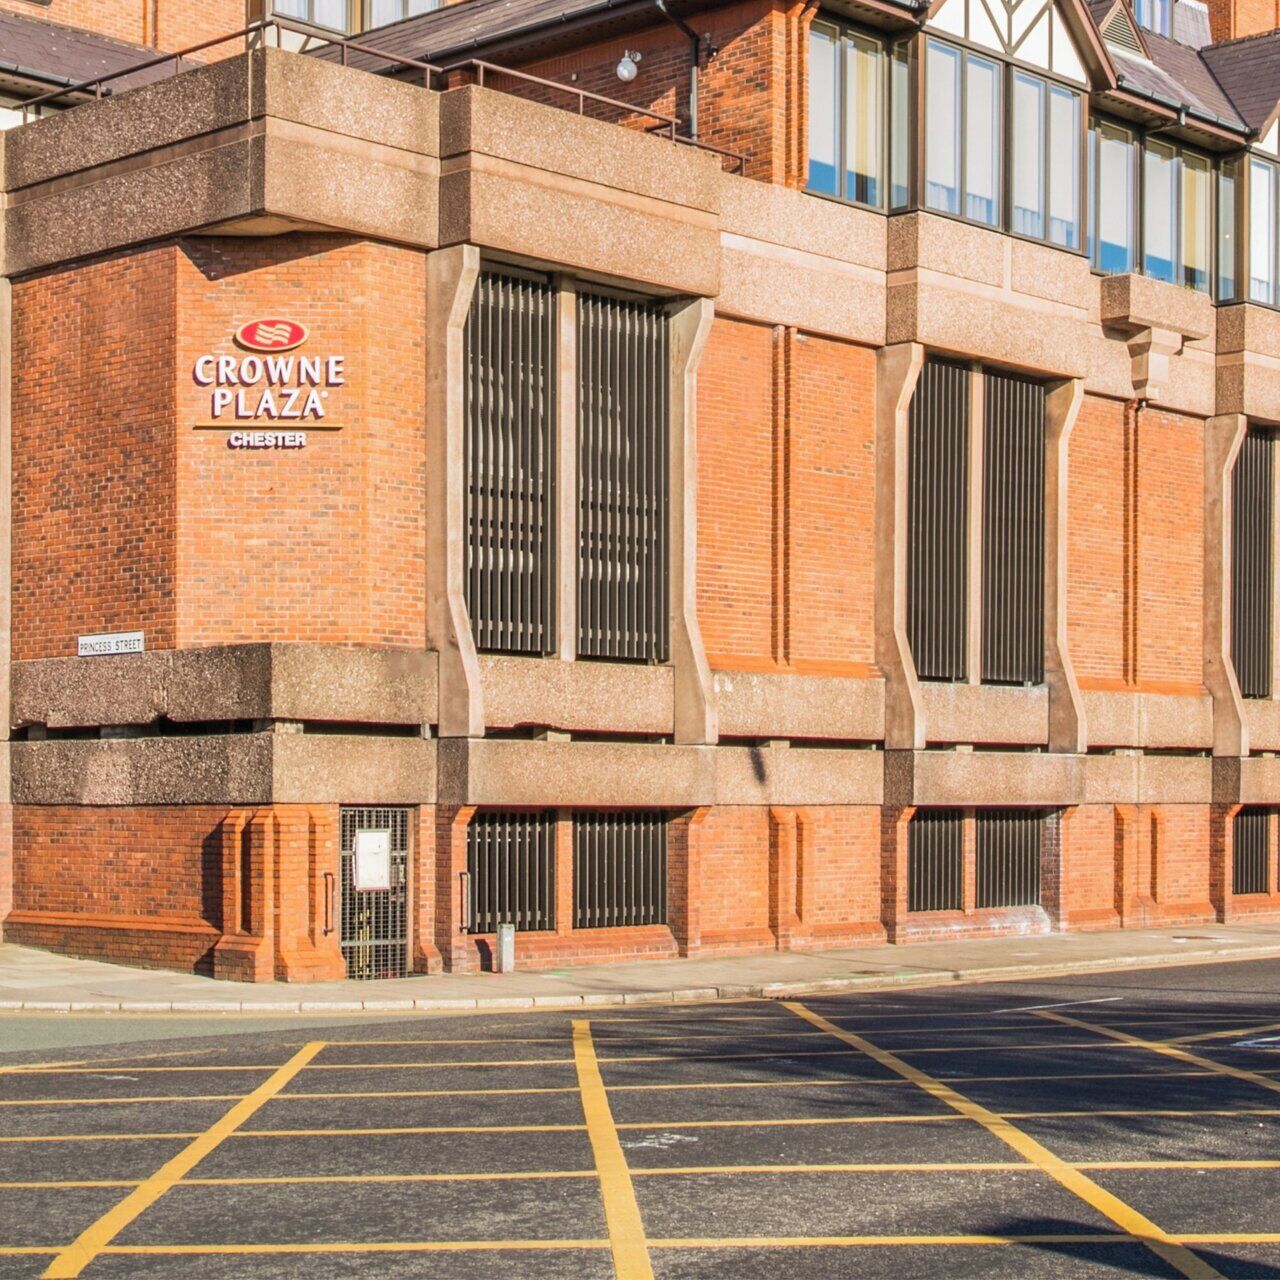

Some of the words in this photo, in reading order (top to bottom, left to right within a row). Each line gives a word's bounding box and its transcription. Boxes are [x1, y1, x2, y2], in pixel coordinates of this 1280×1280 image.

[194, 354, 345, 384] CROWNE
[213, 388, 326, 417] PLAZA
[229, 432, 307, 446] CHESTER
[80, 641, 112, 653] PRINCESS
[115, 638, 141, 651] STREET
